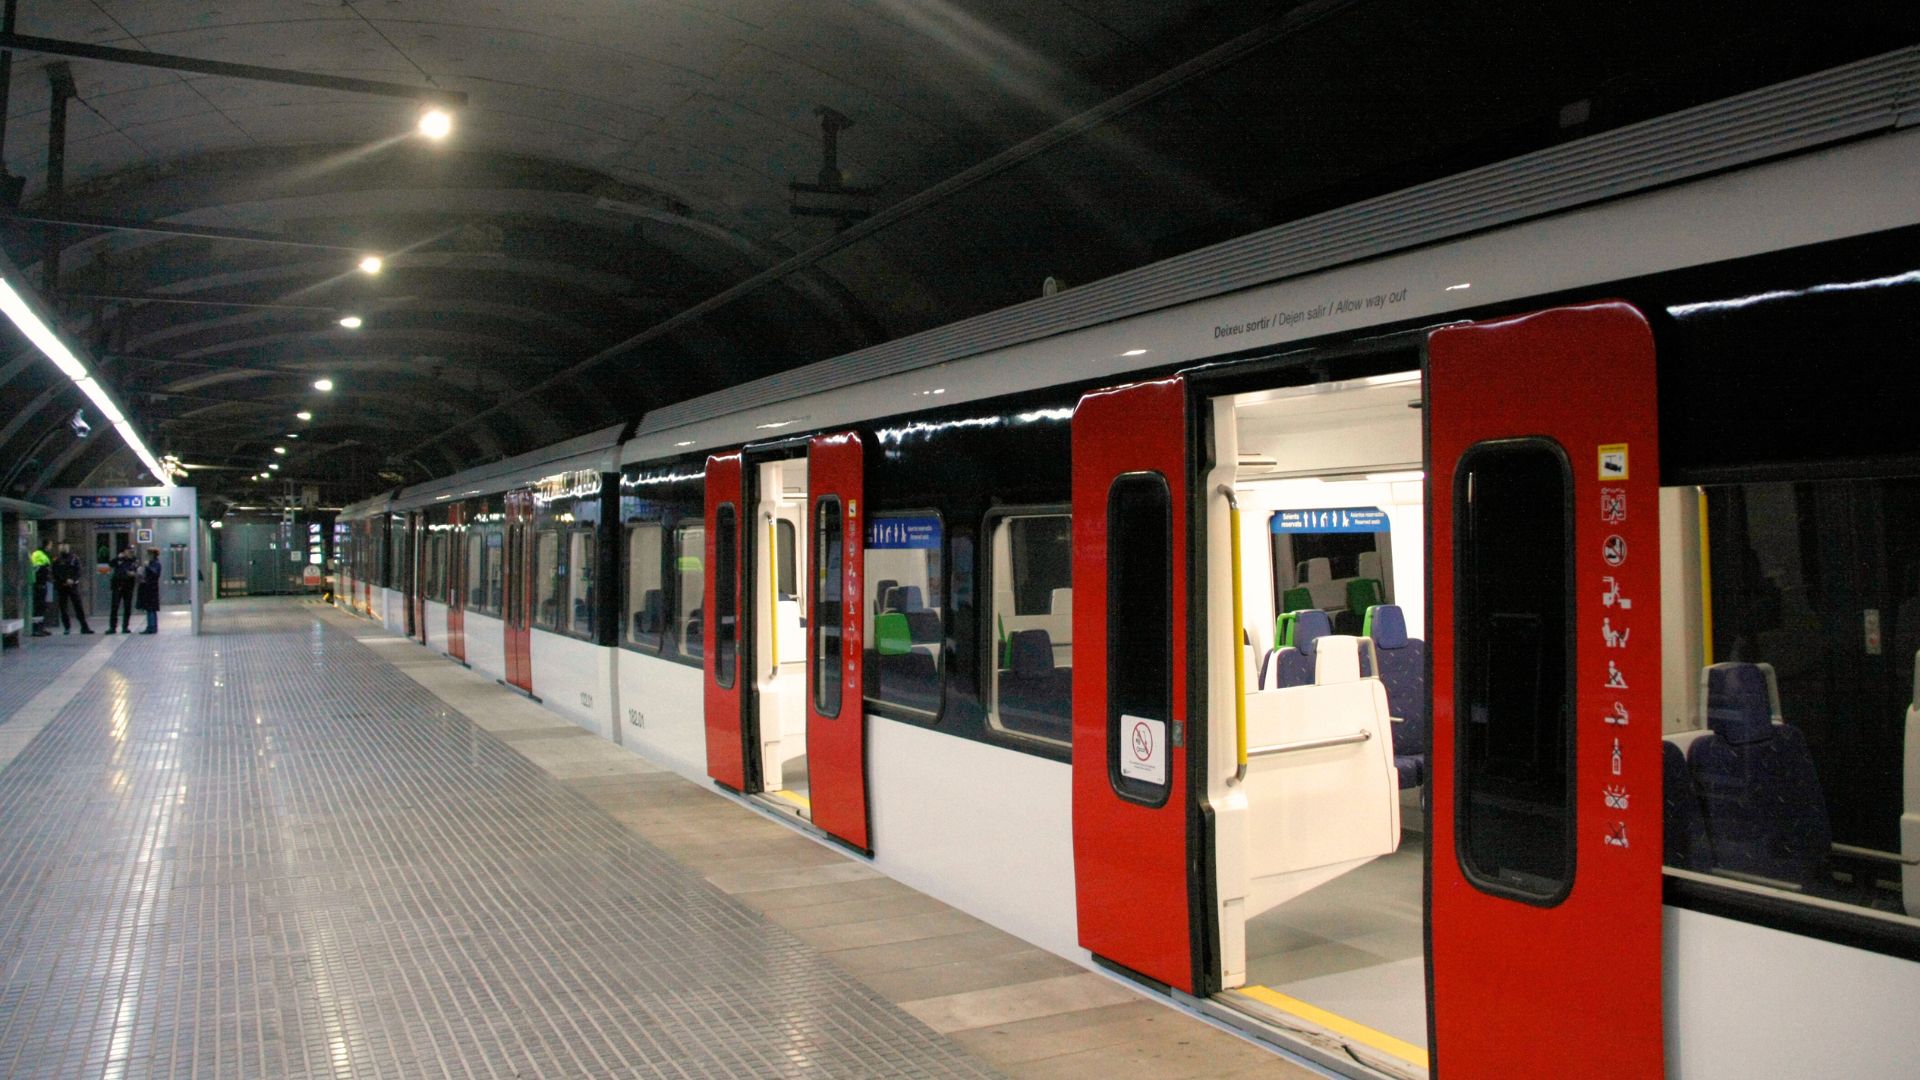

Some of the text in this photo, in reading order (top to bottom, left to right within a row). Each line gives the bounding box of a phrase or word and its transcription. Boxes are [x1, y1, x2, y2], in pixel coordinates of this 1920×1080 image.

[1214, 324, 1244, 338] Deixeu
[1246, 316, 1271, 332] sortir
[1279, 311, 1305, 326] Dejen
[1307, 304, 1326, 320] salir
[1335, 298, 1363, 315] Allow
[1366, 294, 1387, 309] way
[1389, 288, 1408, 304] out
